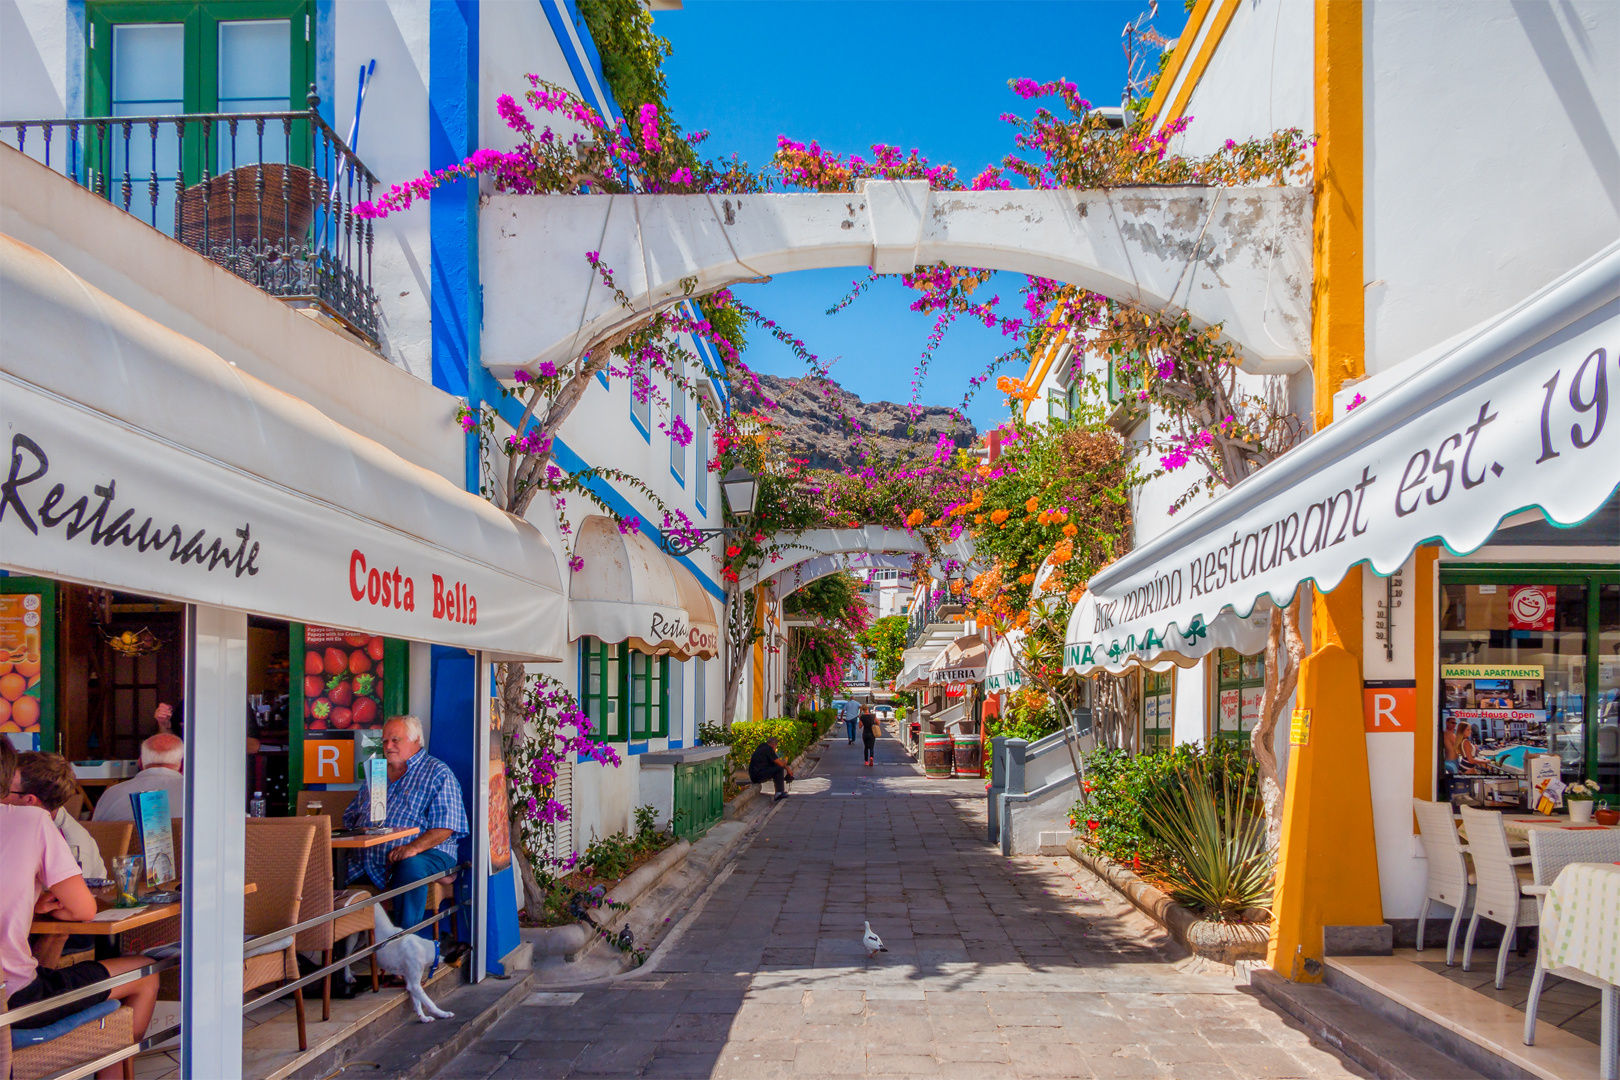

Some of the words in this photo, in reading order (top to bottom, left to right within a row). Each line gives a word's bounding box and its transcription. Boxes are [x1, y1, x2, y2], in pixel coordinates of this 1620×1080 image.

[1395, 399, 1505, 518] est.
[1535, 347, 1620, 465] 19
[0, 433, 260, 578] Restaurante
[349, 549, 415, 613] Costa
[432, 573, 478, 626] Bella
[931, 669, 976, 681] CAFETERIA
[1445, 669, 1482, 677] MARINA
[1484, 669, 1541, 678] APARTMENTS
[1374, 693, 1402, 727] R
[1454, 710, 1479, 719] Show
[1481, 710, 1509, 719] House
[1511, 710, 1535, 720] Open
[317, 745, 340, 778] R
